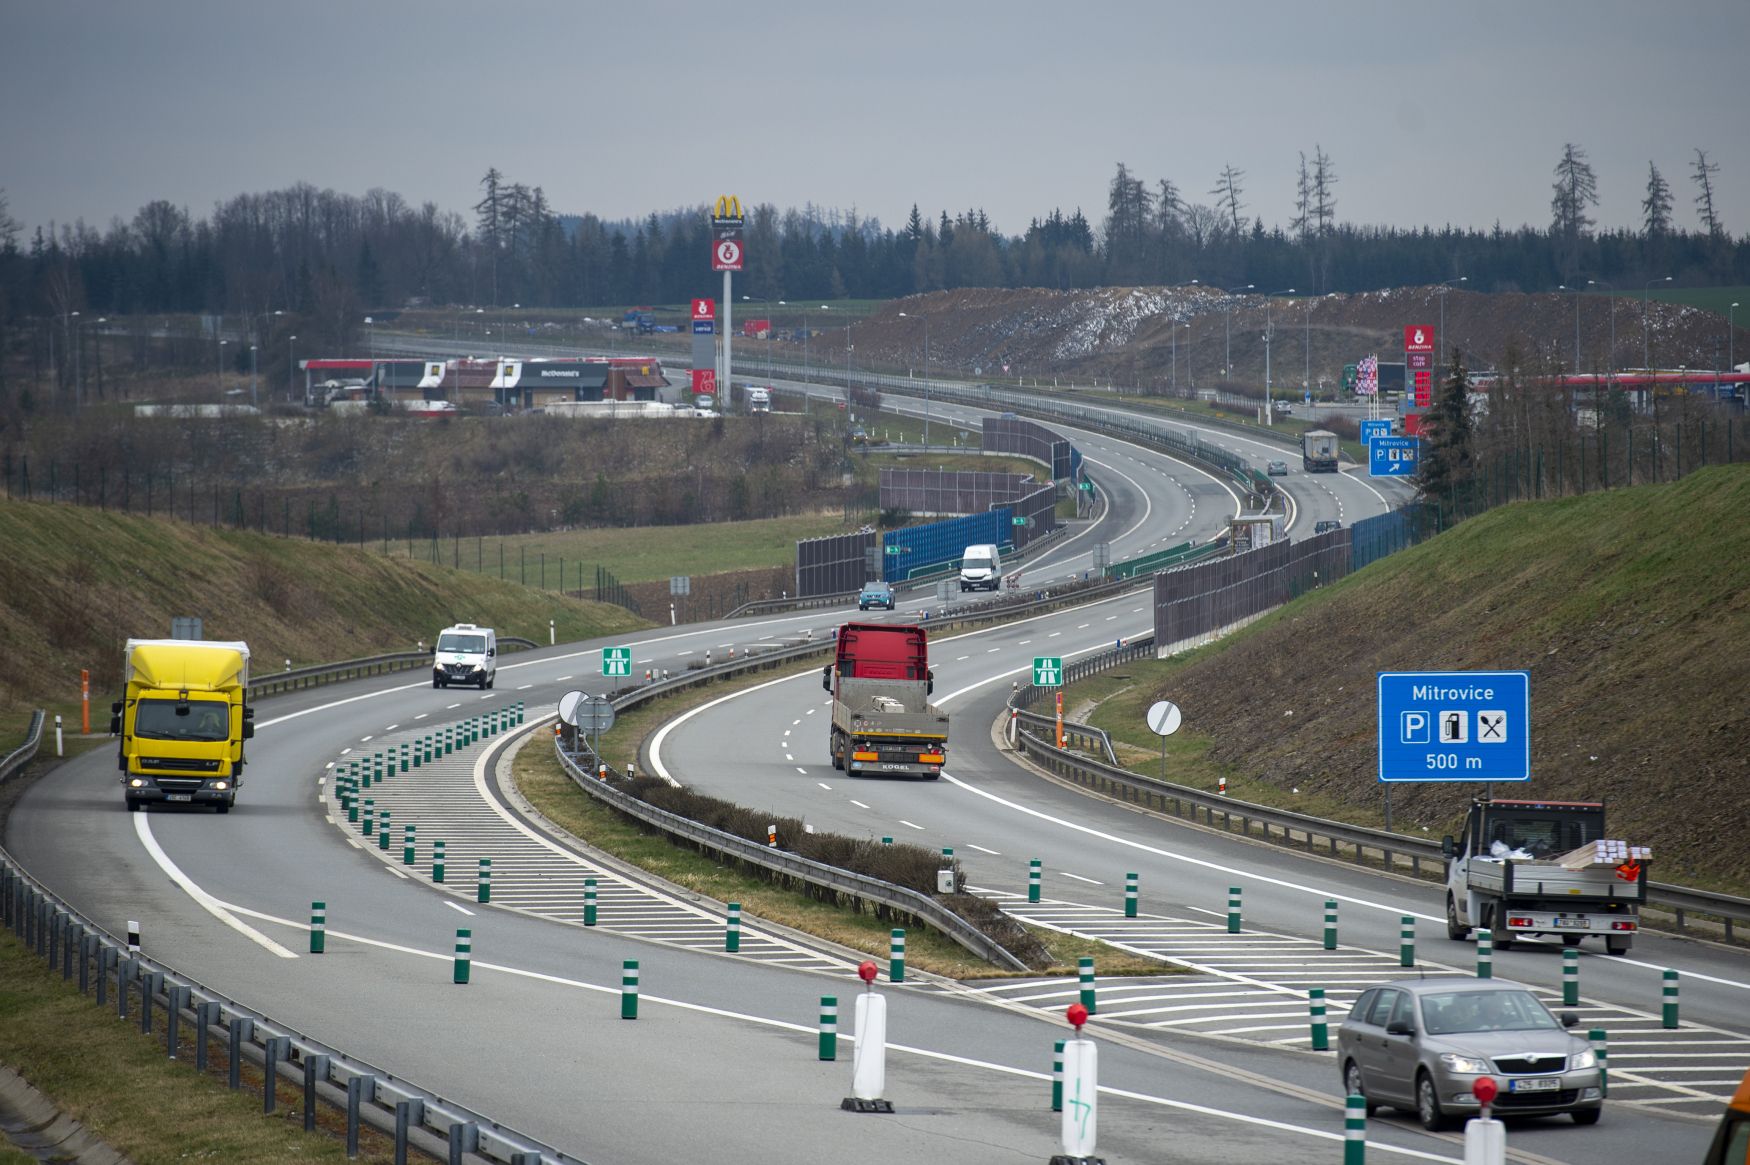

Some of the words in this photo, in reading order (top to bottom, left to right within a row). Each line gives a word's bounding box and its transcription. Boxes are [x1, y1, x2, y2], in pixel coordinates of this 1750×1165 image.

[1379, 439, 1409, 447] Mitrovice
[1412, 685, 1495, 701] Mitrovice
[1406, 713, 1425, 740] P
[1426, 754, 1458, 769] 500
[1465, 757, 1482, 769] m
